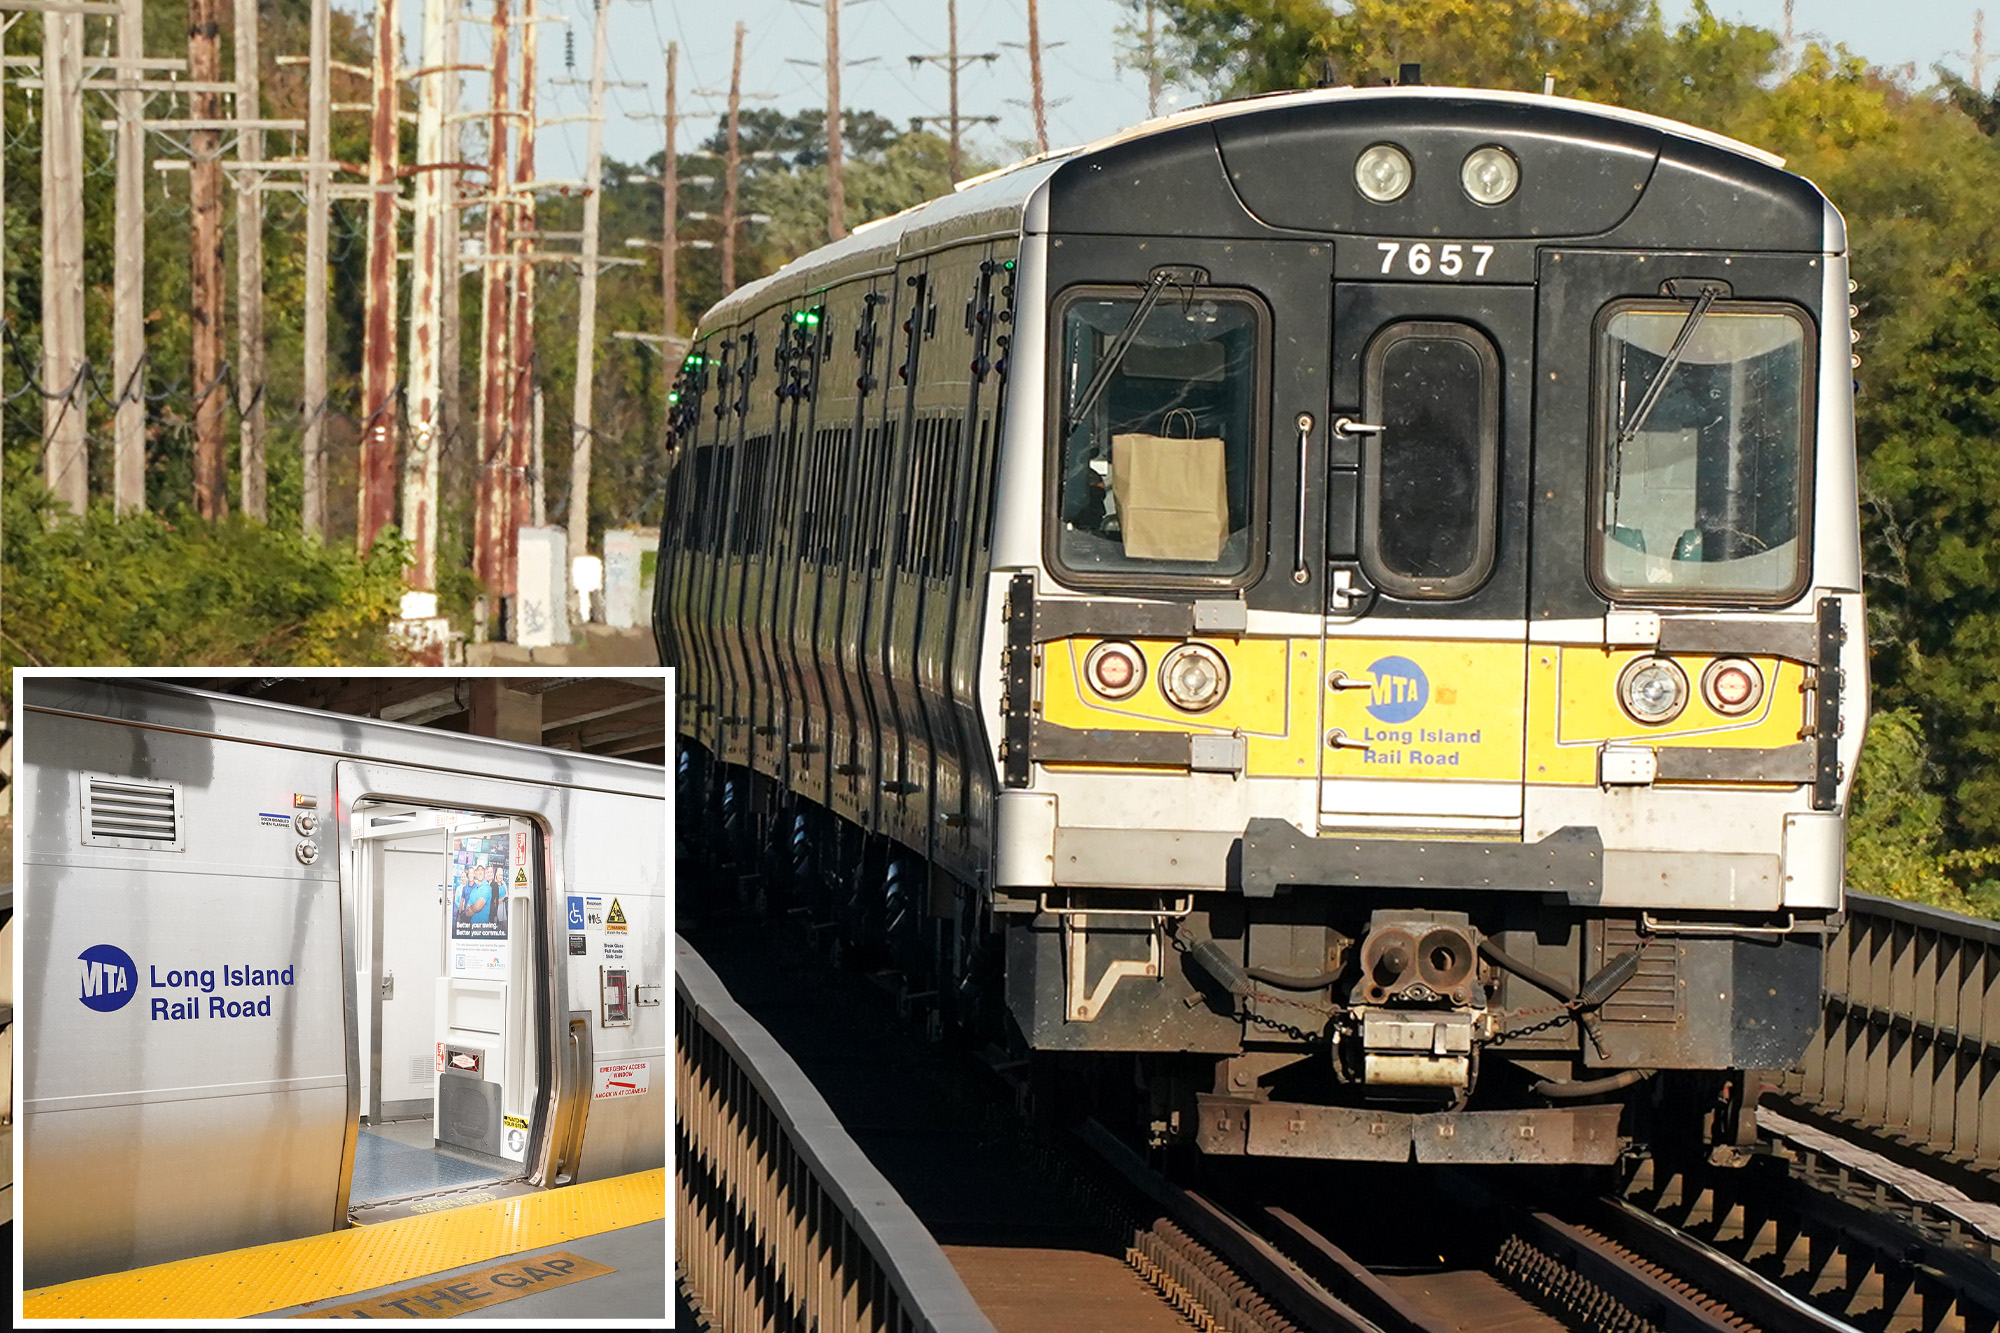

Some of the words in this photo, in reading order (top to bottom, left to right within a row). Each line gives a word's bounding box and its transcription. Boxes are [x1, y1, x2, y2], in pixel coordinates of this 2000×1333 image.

[1377, 242, 1494, 276] 7657
[1367, 672, 1419, 706] MTA
[1364, 727, 1412, 745] Long
[1420, 728, 1481, 743] Island
[1363, 750, 1401, 764] Rail
[1409, 750, 1460, 765] Road
[78, 958, 128, 998] MTA
[150, 965, 215, 993] Long
[223, 964, 294, 986] Island
[151, 997, 200, 1020] Rail
[209, 995, 271, 1018] Road
[379, 1282, 493, 1317] THE
[489, 1259, 575, 1288] GAP
